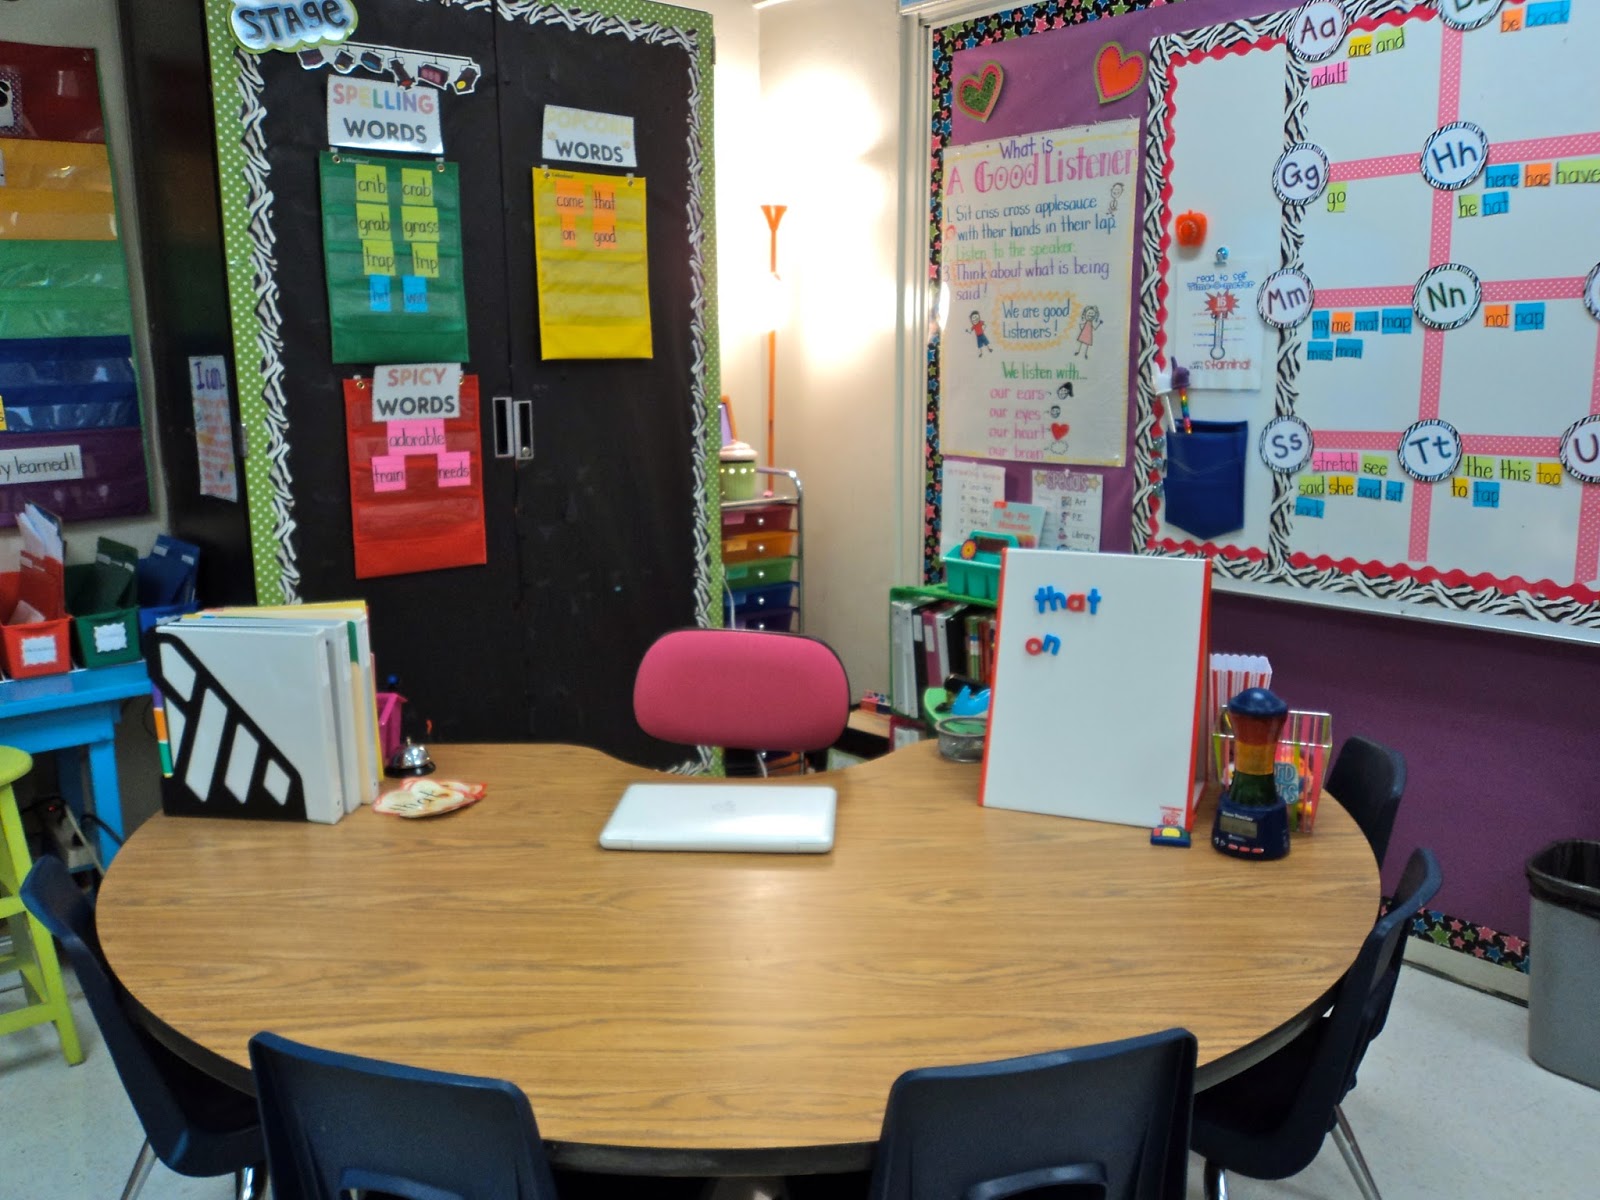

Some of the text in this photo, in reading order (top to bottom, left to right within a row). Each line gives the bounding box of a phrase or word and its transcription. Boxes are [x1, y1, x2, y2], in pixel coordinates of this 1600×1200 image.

[1301, 16, 1336, 44] Aa
[1348, 27, 1405, 57] are and
[1311, 61, 1348, 88] adult
[333, 83, 434, 114] SPELLING
[343, 118, 427, 143] WORDS
[556, 139, 624, 162] WORDS
[999, 136, 1054, 159] What is
[1431, 141, 1478, 174] Hh
[946, 147, 1138, 196] A Good Listener
[1282, 162, 1320, 191] Gg
[1485, 161, 1600, 188] here has have
[358, 174, 431, 197] crib crab
[594, 190, 615, 210] that
[956, 203, 972, 222] Sit
[975, 208, 999, 220] criss
[1003, 204, 1031, 216] cross
[1035, 193, 1097, 216] applesauce
[1327, 191, 1346, 212] go
[1458, 195, 1477, 218] he
[359, 213, 440, 238] grab grass
[562, 226, 616, 247] on good
[957, 224, 978, 241] with
[982, 222, 1006, 239] their
[1010, 219, 1041, 236] hands
[1046, 221, 1057, 233] in
[1061, 215, 1091, 231] their
[365, 247, 438, 273] trap trip
[1009, 240, 1025, 257] the
[957, 262, 987, 280] Think
[991, 260, 1022, 279] about
[1026, 257, 1054, 277] what
[1058, 260, 1069, 275] is
[1074, 256, 1110, 280] being
[1197, 274, 1215, 282] read
[1268, 287, 1307, 315] Mm
[1426, 282, 1467, 312] Nn
[1002, 297, 1070, 323] We are good
[1484, 304, 1545, 331] not nap
[1332, 319, 1351, 333] me
[1382, 315, 1412, 334] map
[388, 367, 447, 387] SPICY
[1002, 361, 1019, 380] We
[1022, 362, 1052, 380] listen
[377, 396, 455, 416] WORDS
[990, 388, 1046, 401] our ears
[989, 407, 1042, 426] our eyes
[389, 427, 445, 447] adorable
[989, 424, 1046, 440] our heart
[988, 444, 1044, 460] our brain
[1272, 434, 1302, 459] Ss
[1409, 435, 1452, 464] Tt
[374, 461, 469, 483] train needs
[1312, 453, 1388, 476] stretch see
[1464, 456, 1561, 485] the this too
[1298, 476, 1324, 495] said
[1329, 477, 1354, 495] she
[1451, 478, 1468, 497] to
[1035, 585, 1102, 615] that
[1025, 633, 1061, 656] on
